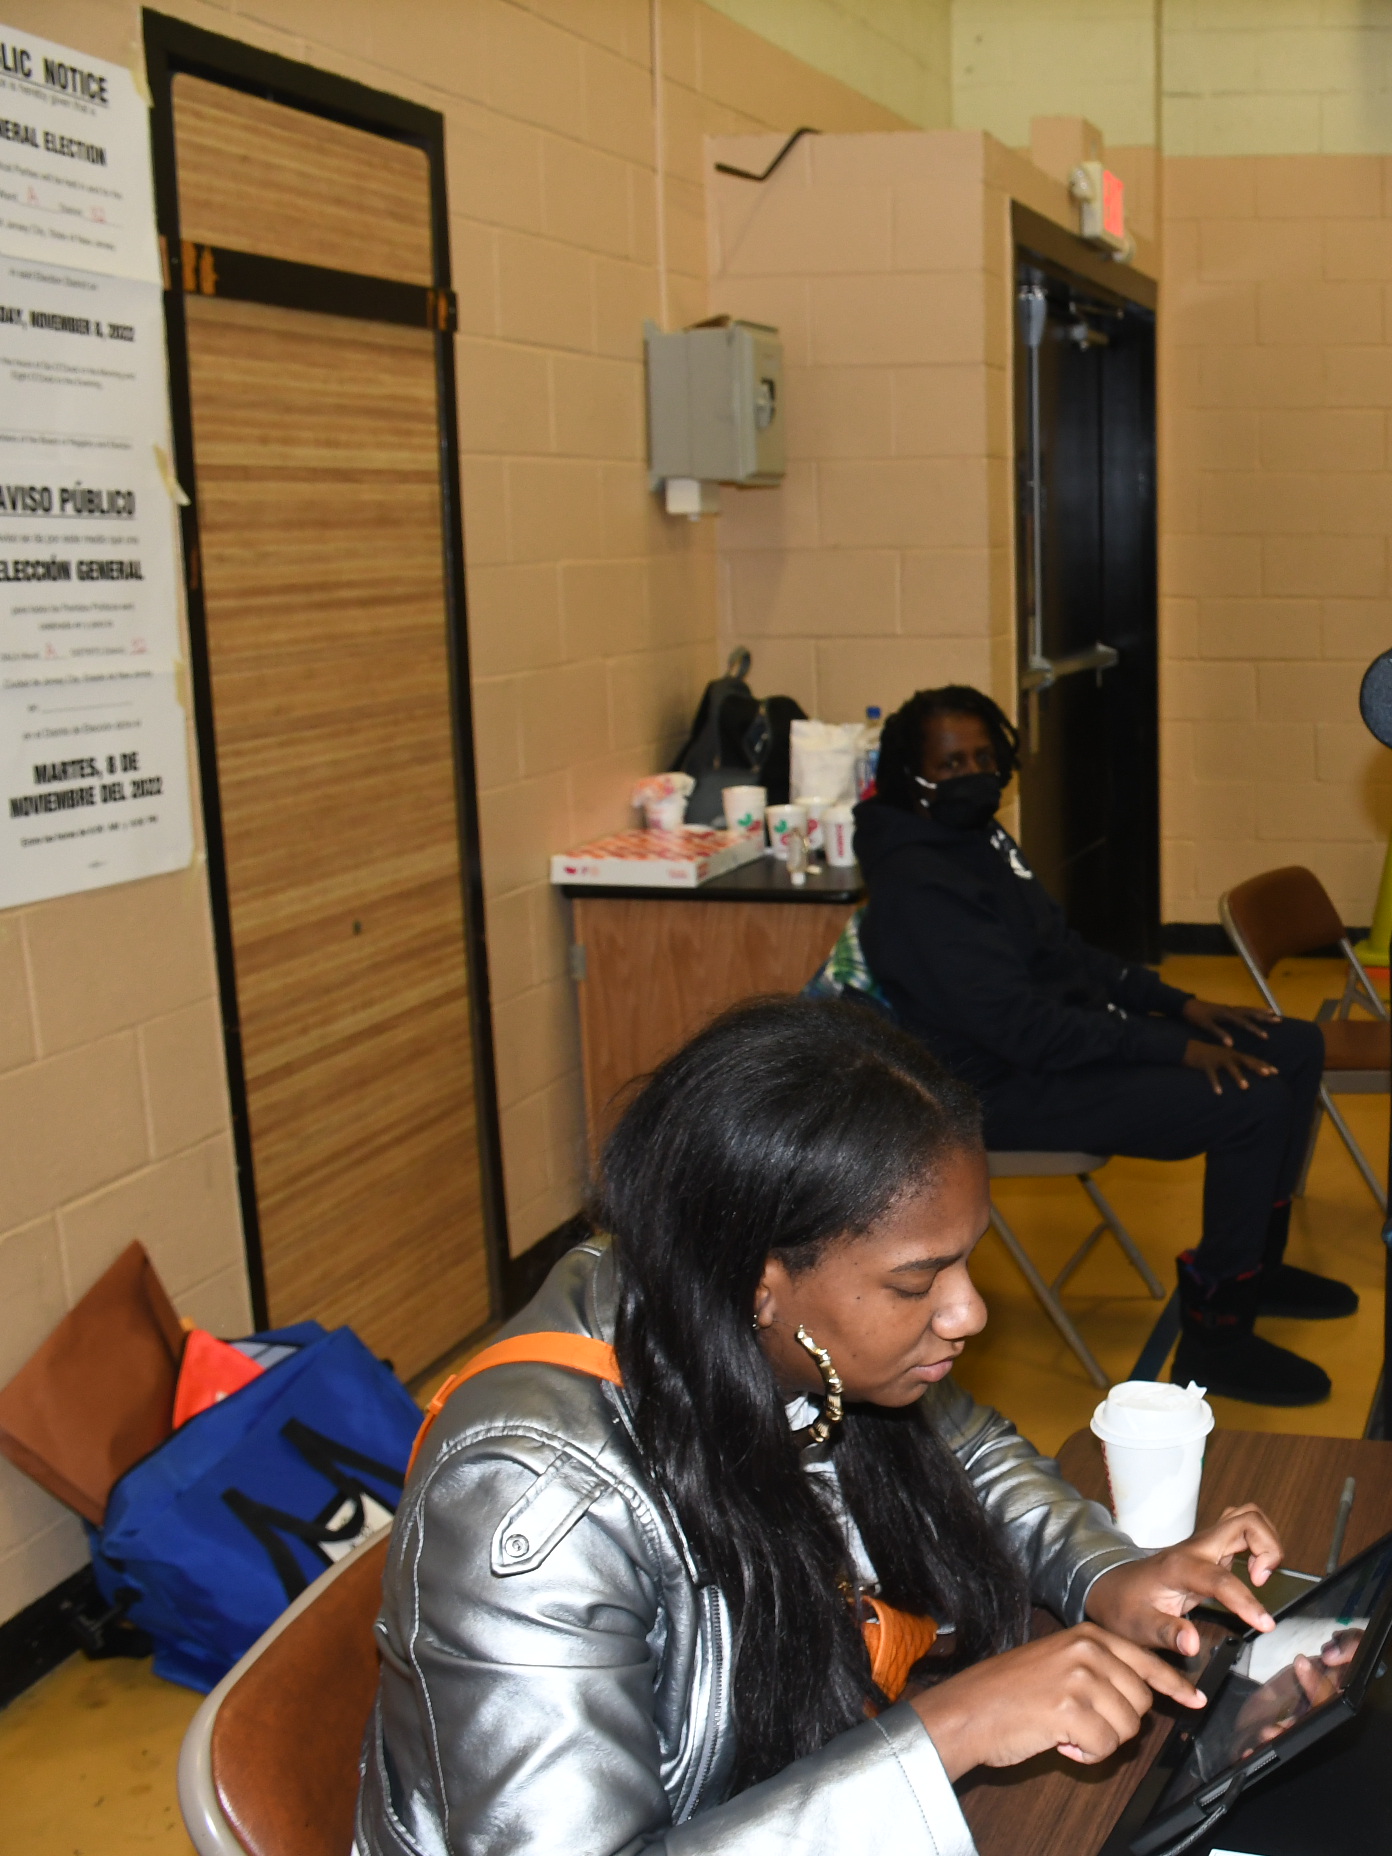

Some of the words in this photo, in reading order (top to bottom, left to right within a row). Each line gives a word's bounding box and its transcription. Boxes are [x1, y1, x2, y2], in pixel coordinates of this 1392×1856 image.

[0, 42, 31, 78] LIC
[44, 57, 107, 103] NOTICE
[43, 130, 107, 167] ELECTION
[29, 309, 91, 336] NOVEMBER
[59, 480, 136, 515] PÚBLICO
[77, 559, 143, 581] GENERAL
[119, 750, 140, 773] DE
[9, 784, 97, 820] NOVIEMBRE
[100, 781, 127, 805] DEL
[130, 775, 164, 800] 2022
